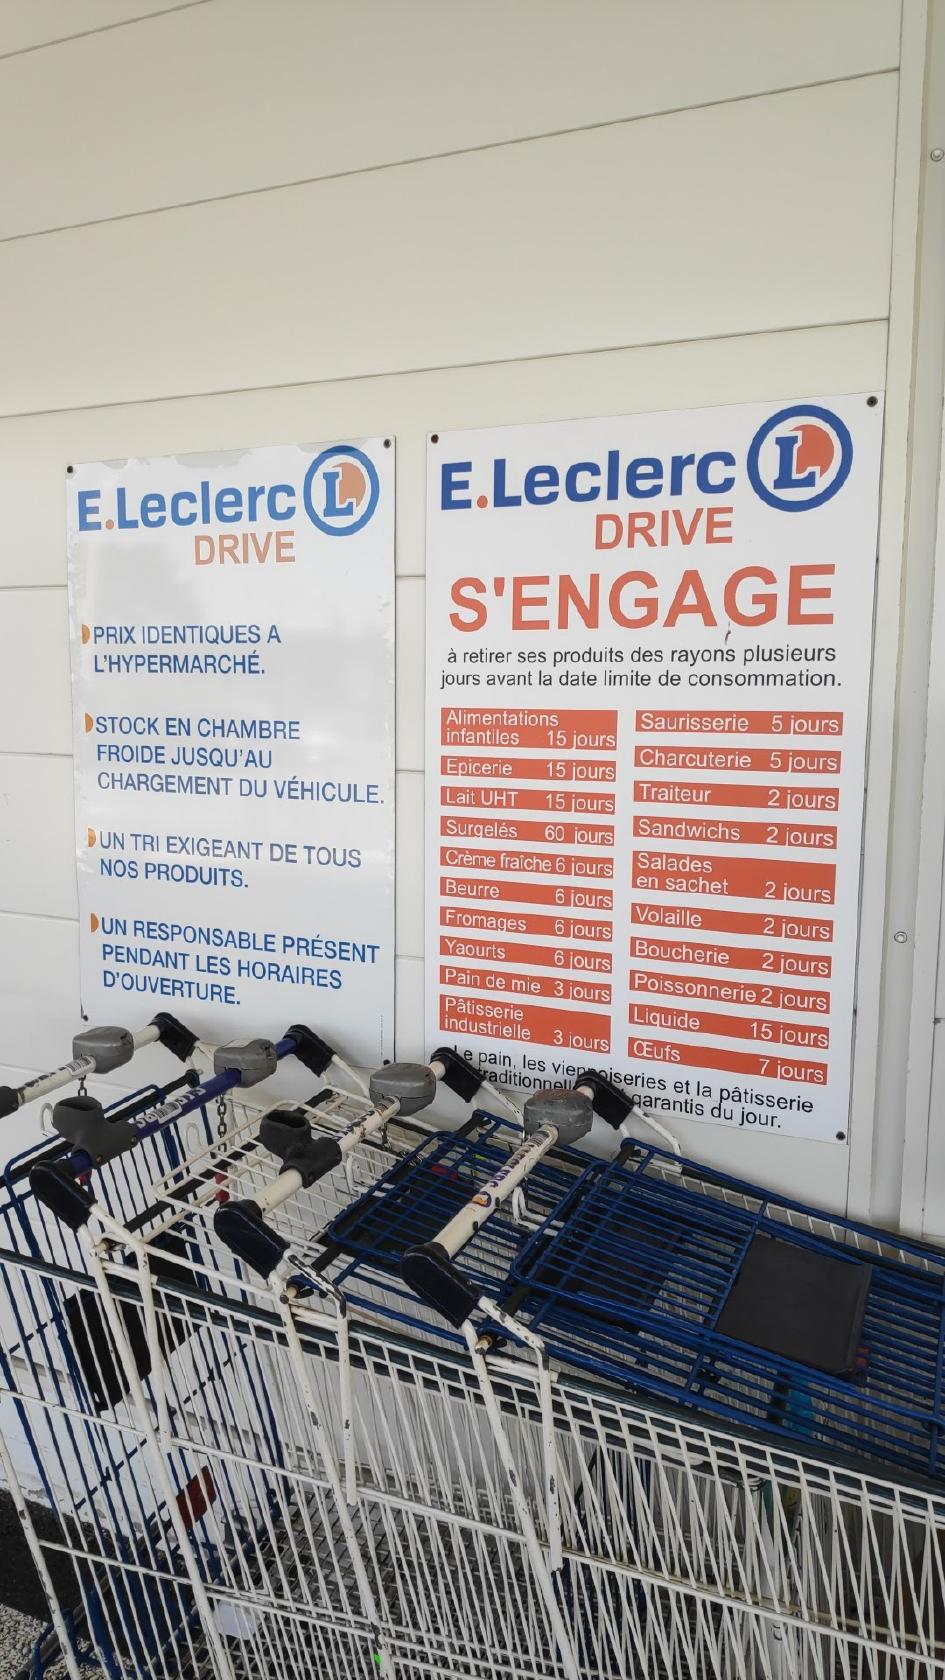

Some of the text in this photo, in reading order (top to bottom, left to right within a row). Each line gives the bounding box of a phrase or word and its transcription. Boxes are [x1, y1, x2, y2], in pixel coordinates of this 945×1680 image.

[441, 450, 736, 510] E.Leclerc
[78, 481, 296, 531] E.Leclerc
[595, 507, 733, 550] DRIVE
[194, 531, 295, 565] DRIVE
[449, 564, 835, 632] S'ENGAGE
[94, 625, 281, 646] PRIX IDENTIQUES A
[94, 651, 265, 674] L'HYPERMARCHÉ.
[448, 644, 836, 668] à retirer ses produits des rayons plusieurs
[440, 671, 841, 690] jours avant la date limite de consommation.
[96, 717, 300, 739] STOCK EN CHAMBRE
[447, 710, 558, 726] Alimentations
[641, 713, 839, 735] Saurisserie 5 jours
[446, 728, 616, 750] infantiles 15 jours
[97, 745, 272, 768] FROIDE JUSQU'AU
[447, 759, 615, 780] Epicerie 15 jours
[640, 749, 837, 772] Charcuterie 5 jours
[98, 772, 384, 804] CHARGEMENT DU VÉHICULE.
[446, 789, 614, 812] Lait UHT 15 jours
[640, 784, 836, 809] Traiteur 2 jours
[446, 820, 613, 844] Surgelés 60 jours
[639, 819, 834, 846] Sandwichs 2 jours
[100, 832, 361, 868] UN TRI EXIGEANT DE TOUS
[446, 850, 612, 876] Crème fraîche 6 jours
[638, 853, 712, 873] Salades
[100, 859, 248, 888] NOS PRODUITS.
[446, 880, 612, 907] Beurre 6 jours
[637, 876, 831, 902] en sachet 2 jours
[446, 910, 611, 939] Fromages 6 jours
[635, 906, 830, 939] Volaille 2 jours
[102, 917, 380, 963] UN RESPONSABLE PRÉSENT
[445, 939, 611, 970] Yaourts 6 jours
[103, 944, 341, 990] PENDANT LES HORAIRES
[635, 940, 828, 975] Boucherie 2 jours
[103, 971, 240, 1005] D'OUVERTURE.
[446, 969, 610, 1001] Pain de mie 3 jours
[635, 974, 827, 1011] Poissonnerie 2 jours
[445, 998, 523, 1021] Pâtisserie
[445, 1015, 609, 1051] industrielle 3 jours
[634, 1007, 828, 1047] Liquide 15 jours
[633, 1041, 823, 1082] Œufs 7 jours
[478, 1051, 516, 1071] pain,
[523, 1054, 546, 1072] les
[674, 1080, 690, 1095] et
[697, 1081, 711, 1097] la
[720, 1087, 813, 1113] pâtisserie
[632, 1093, 704, 1116] garantis
[711, 1103, 733, 1120] du
[739, 1108, 781, 1128] jour.
